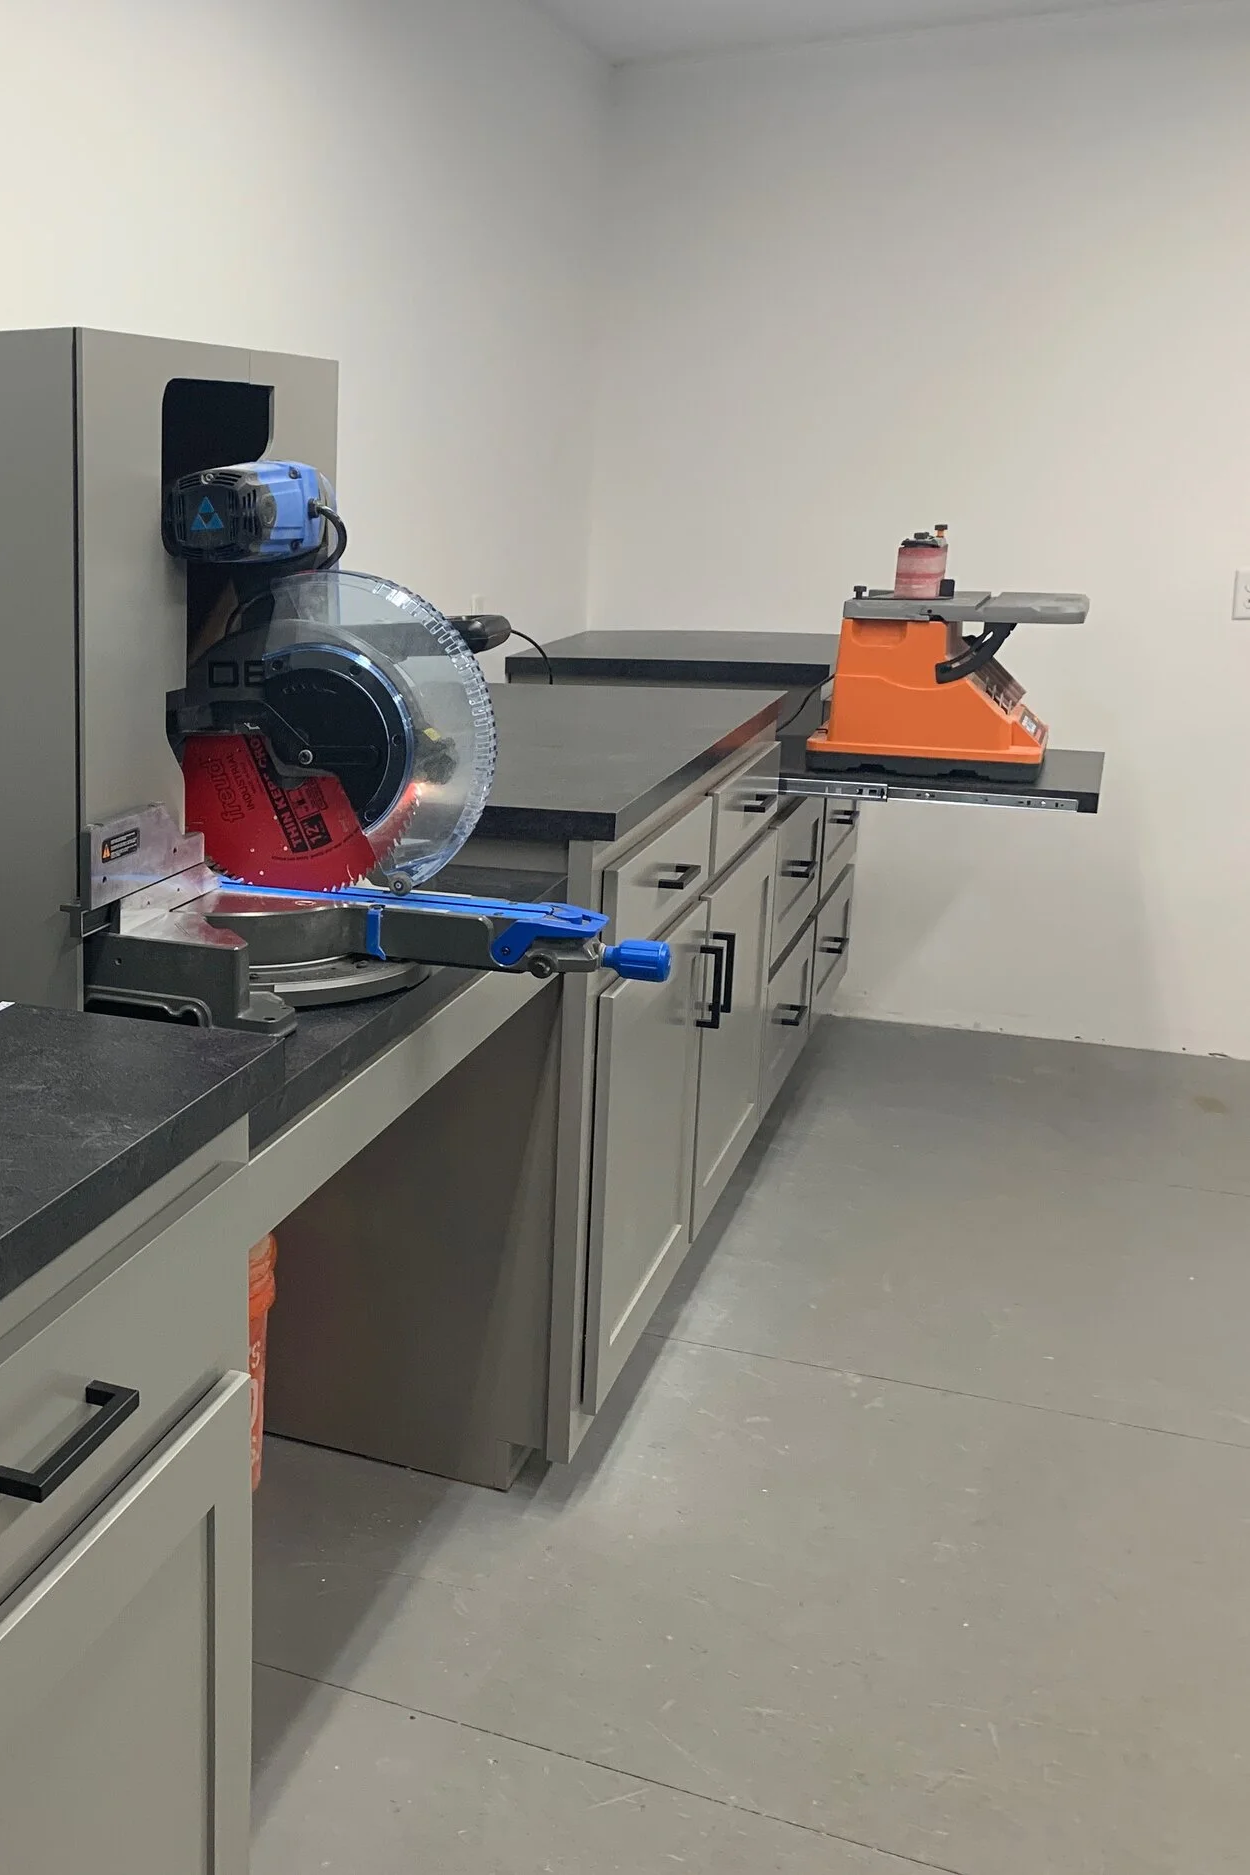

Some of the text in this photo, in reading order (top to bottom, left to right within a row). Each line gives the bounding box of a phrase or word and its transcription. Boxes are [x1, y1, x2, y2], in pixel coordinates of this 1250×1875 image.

[200, 758, 246, 823] freud
[226, 752, 256, 812] INDUSTRIAL
[280, 811, 303, 849] THIN
